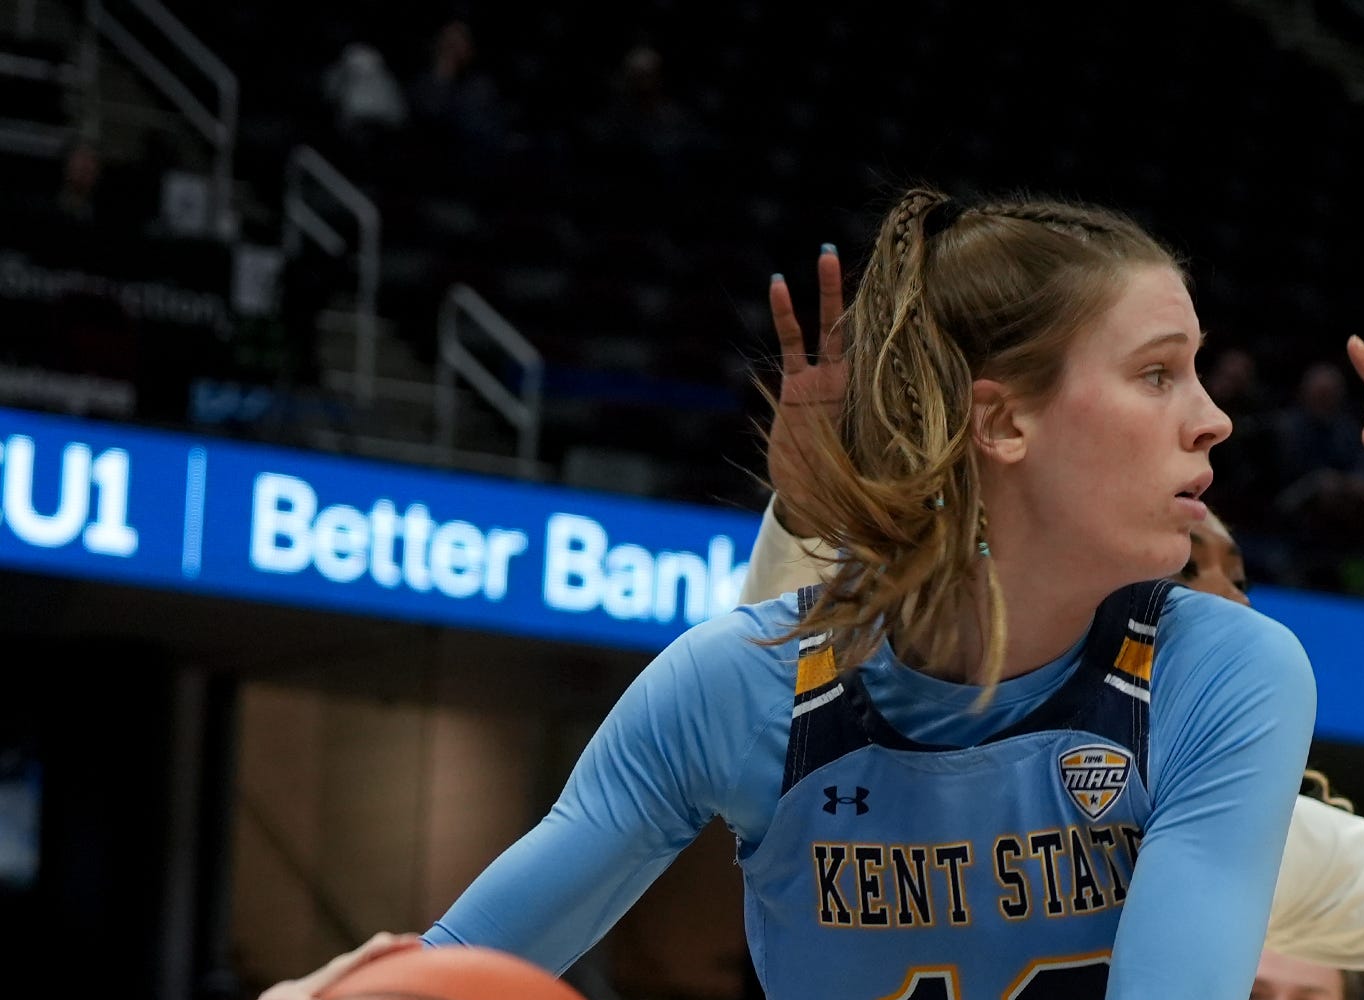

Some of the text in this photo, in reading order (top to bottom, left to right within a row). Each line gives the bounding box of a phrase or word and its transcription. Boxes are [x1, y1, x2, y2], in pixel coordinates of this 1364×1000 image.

[0, 434, 139, 558] U1
[250, 472, 527, 600] Better
[1064, 769, 1125, 788] MAC
[812, 840, 974, 929] KENT
